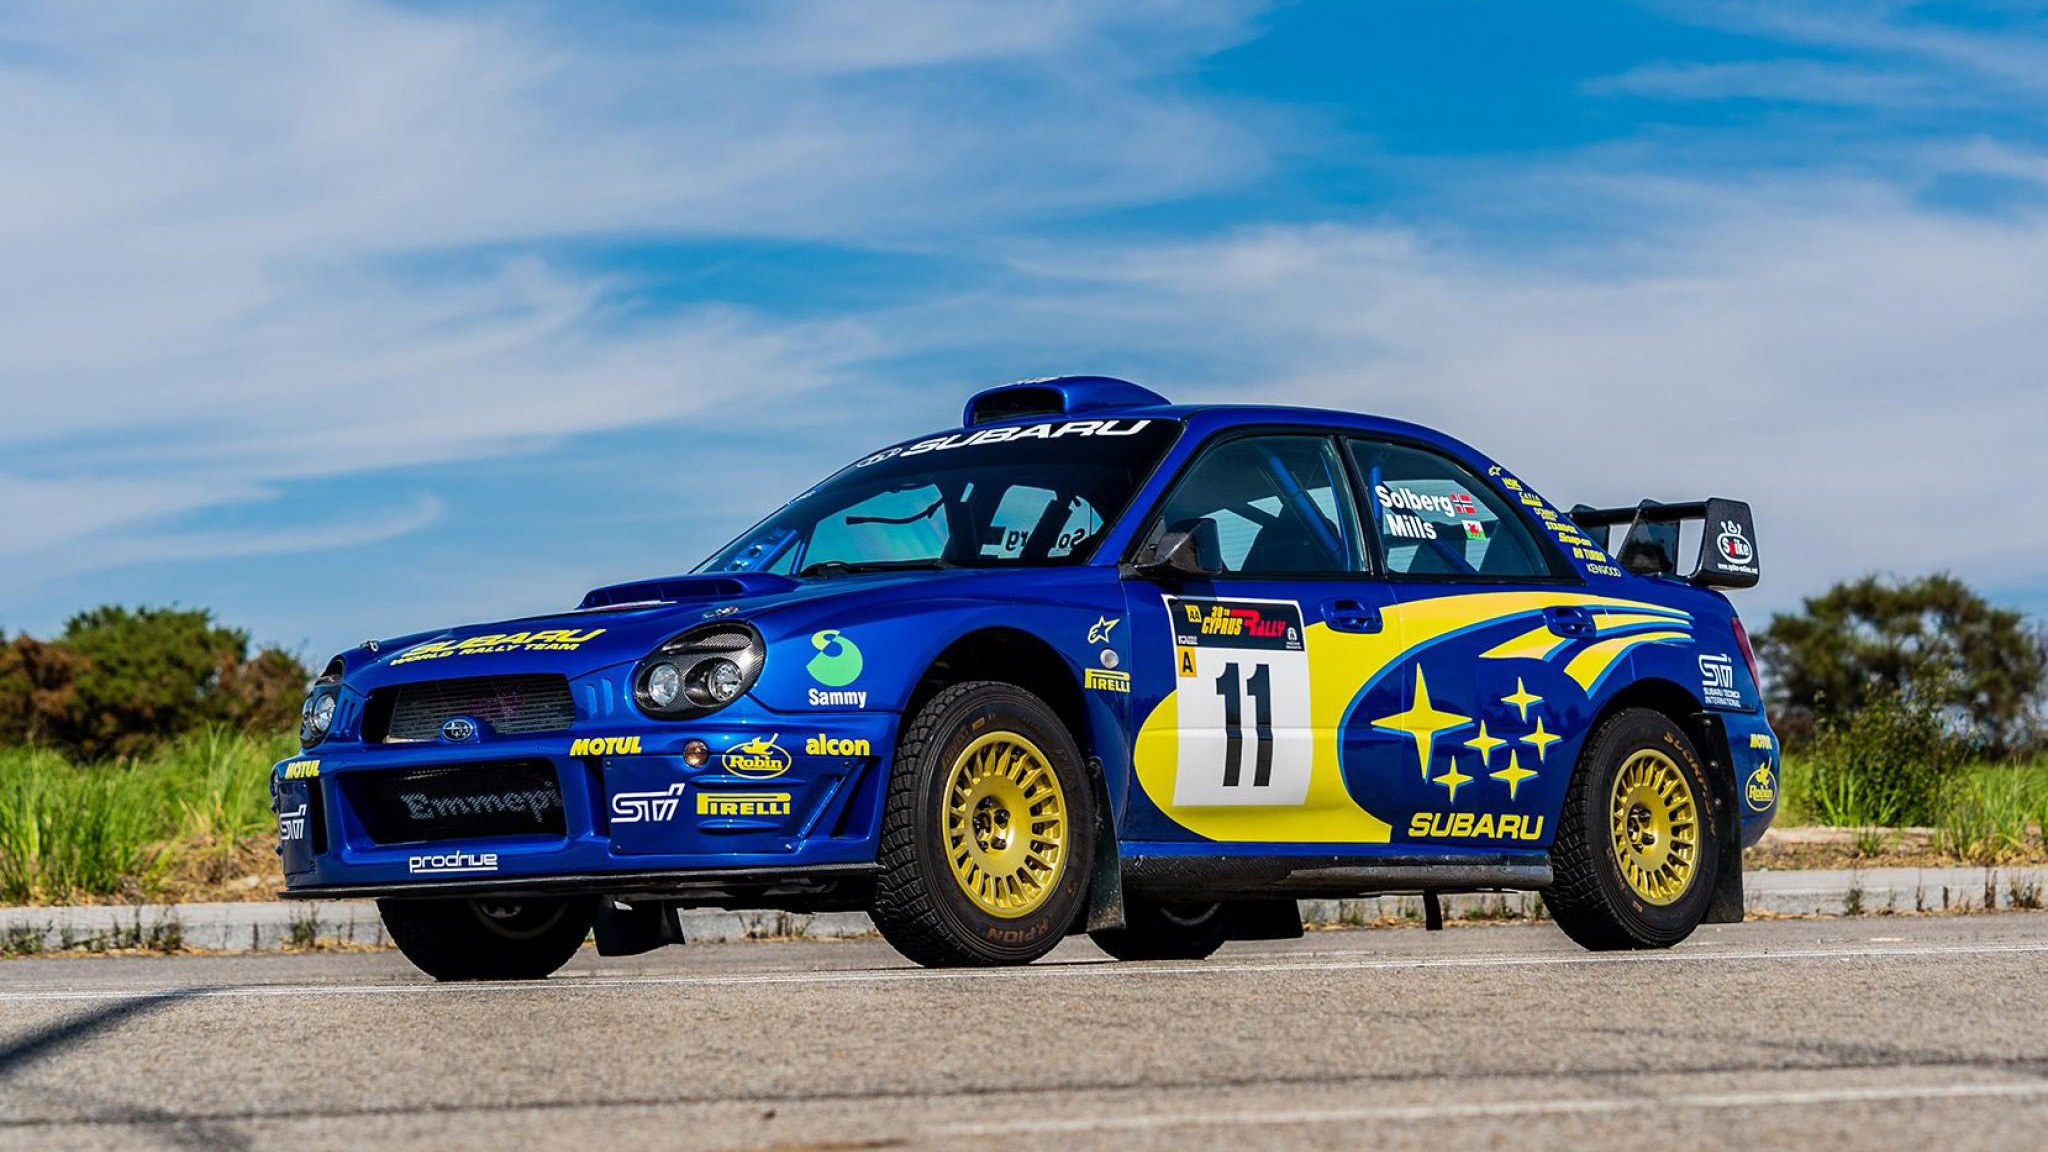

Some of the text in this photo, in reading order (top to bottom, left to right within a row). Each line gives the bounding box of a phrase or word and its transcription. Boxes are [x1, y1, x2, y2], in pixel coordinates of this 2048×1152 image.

[900, 420, 1151, 457] SUBARU
[1375, 485, 1455, 518] Solberg
[1386, 514, 1437, 539] Mills
[1201, 608, 1286, 637] CYPRUS RALLY
[390, 643, 580, 666] WORLD RALLY TEAM
[402, 628, 607, 658] SUBARU
[1182, 651, 1193, 673] A
[1084, 668, 1131, 693] PIRELLI
[808, 688, 867, 709] Sammy
[1216, 662, 1274, 787] 11
[570, 736, 642, 756] MOTUL
[805, 734, 870, 756] alcon
[285, 760, 320, 779] MOTUL
[730, 754, 783, 771] Robin
[696, 792, 791, 815] PIRELLI
[1408, 812, 1544, 840] SUBARU
[410, 851, 498, 874] prodrive
